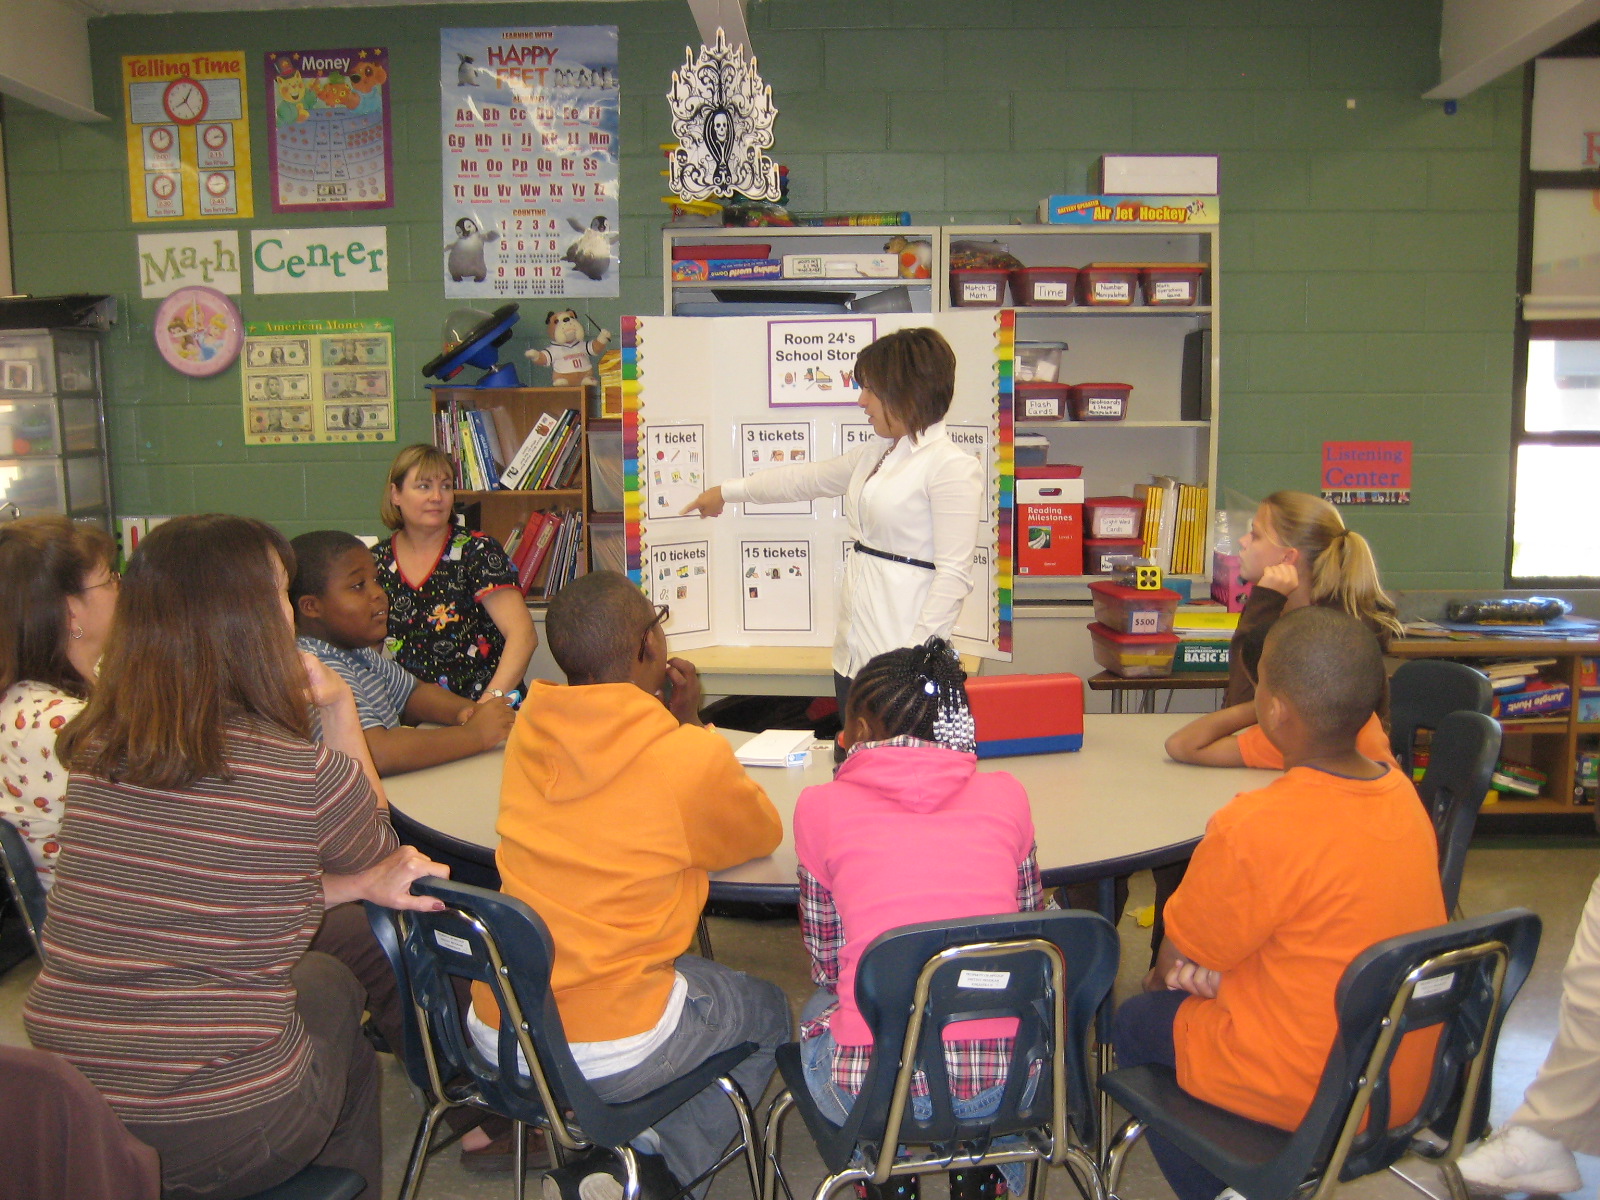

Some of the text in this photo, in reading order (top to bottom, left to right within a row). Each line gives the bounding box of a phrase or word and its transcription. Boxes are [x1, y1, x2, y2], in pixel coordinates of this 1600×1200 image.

[502, 32, 533, 40] LEARNING
[487, 44, 559, 66] HAPPY
[128, 56, 241, 78] Telling Time
[301, 56, 350, 72] Money
[496, 67, 549, 89] FEET
[456, 108, 473, 121] Aa
[482, 108, 500, 120] Bb
[510, 108, 526, 120] Cc
[564, 106, 579, 120] Ee
[588, 106, 600, 120] Ff
[448, 134, 466, 148] Gg
[475, 134, 492, 146] Hh
[521, 133, 532, 146] Jj
[588, 132, 610, 145] Mm
[460, 157, 598, 172] Nn Oo Pp Qq Rr Ss
[454, 182, 606, 197] Tt Uu Vv Ww Xx Yy Zz
[512, 208, 546, 216] COUNTING
[1093, 206, 1187, 222] Air Jet Hockey
[502, 220, 555, 230] 1 2 3 4
[500, 240, 556, 250] 5 6 7 8
[141, 238, 384, 286] Math Center
[498, 266, 562, 277] 9 10 11 12
[1038, 285, 1064, 298] Time
[265, 320, 366, 332] American Money
[784, 332, 856, 345] Room 24's
[776, 350, 822, 362] School
[1030, 400, 1052, 408] Flash
[655, 432, 696, 444] 1 ticket
[747, 430, 805, 442] 3 tickets
[847, 431, 855, 442] 5
[952, 432, 984, 444] tickets
[1326, 446, 1404, 464] Listening
[1326, 466, 1401, 486] Center
[1028, 506, 1062, 514] Reading
[654, 548, 706, 562] 10 tickets
[744, 547, 807, 558] 15 tickets
[1184, 652, 1216, 662] BASIC
[1534, 692, 1565, 706] Jungle
